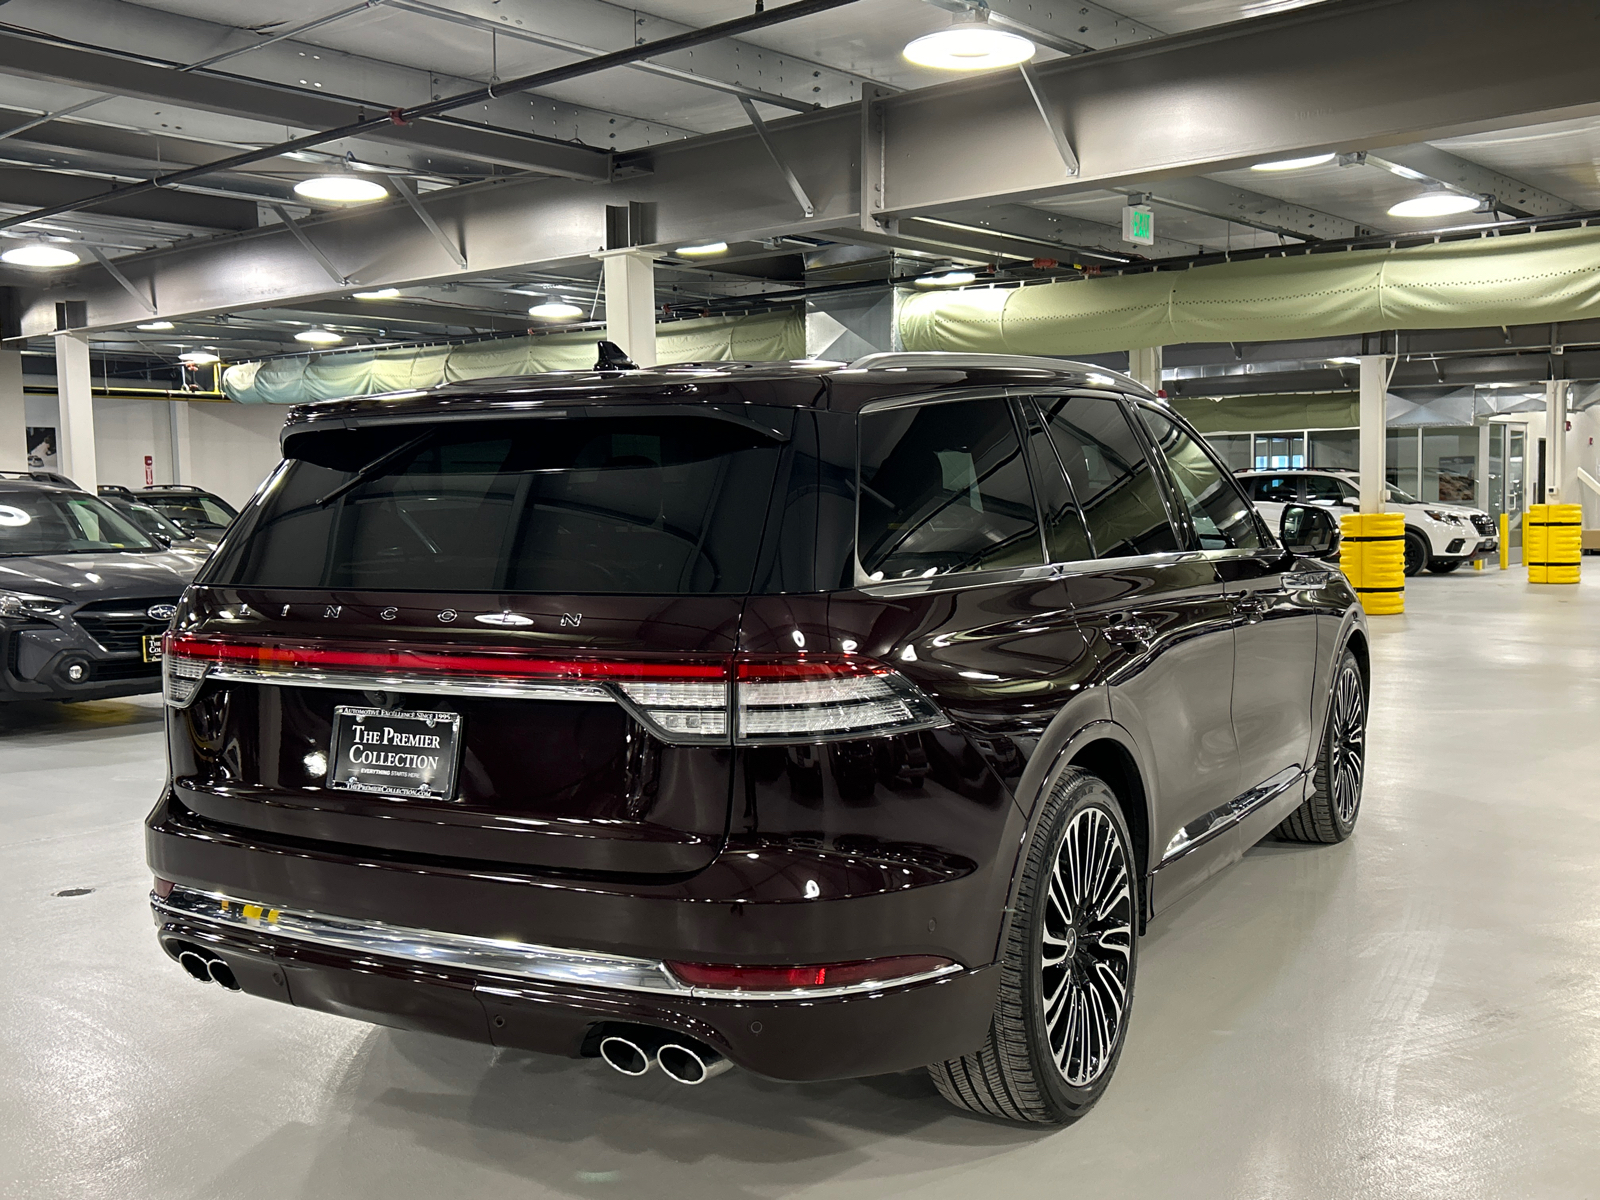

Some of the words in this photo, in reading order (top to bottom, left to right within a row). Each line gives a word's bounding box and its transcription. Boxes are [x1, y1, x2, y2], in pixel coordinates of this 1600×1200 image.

[1134, 211, 1150, 239] EXIT
[239, 603, 582, 627] LINCOLN
[344, 707, 379, 716] AUTOMOTIVE
[381, 709, 415, 718] EXCELLENCE
[416, 712, 433, 720] SINCE
[352, 725, 381, 744] THE
[382, 727, 440, 749] PREMIER
[349, 744, 439, 770] COLLECTION
[361, 768, 391, 776] EVERYTHING
